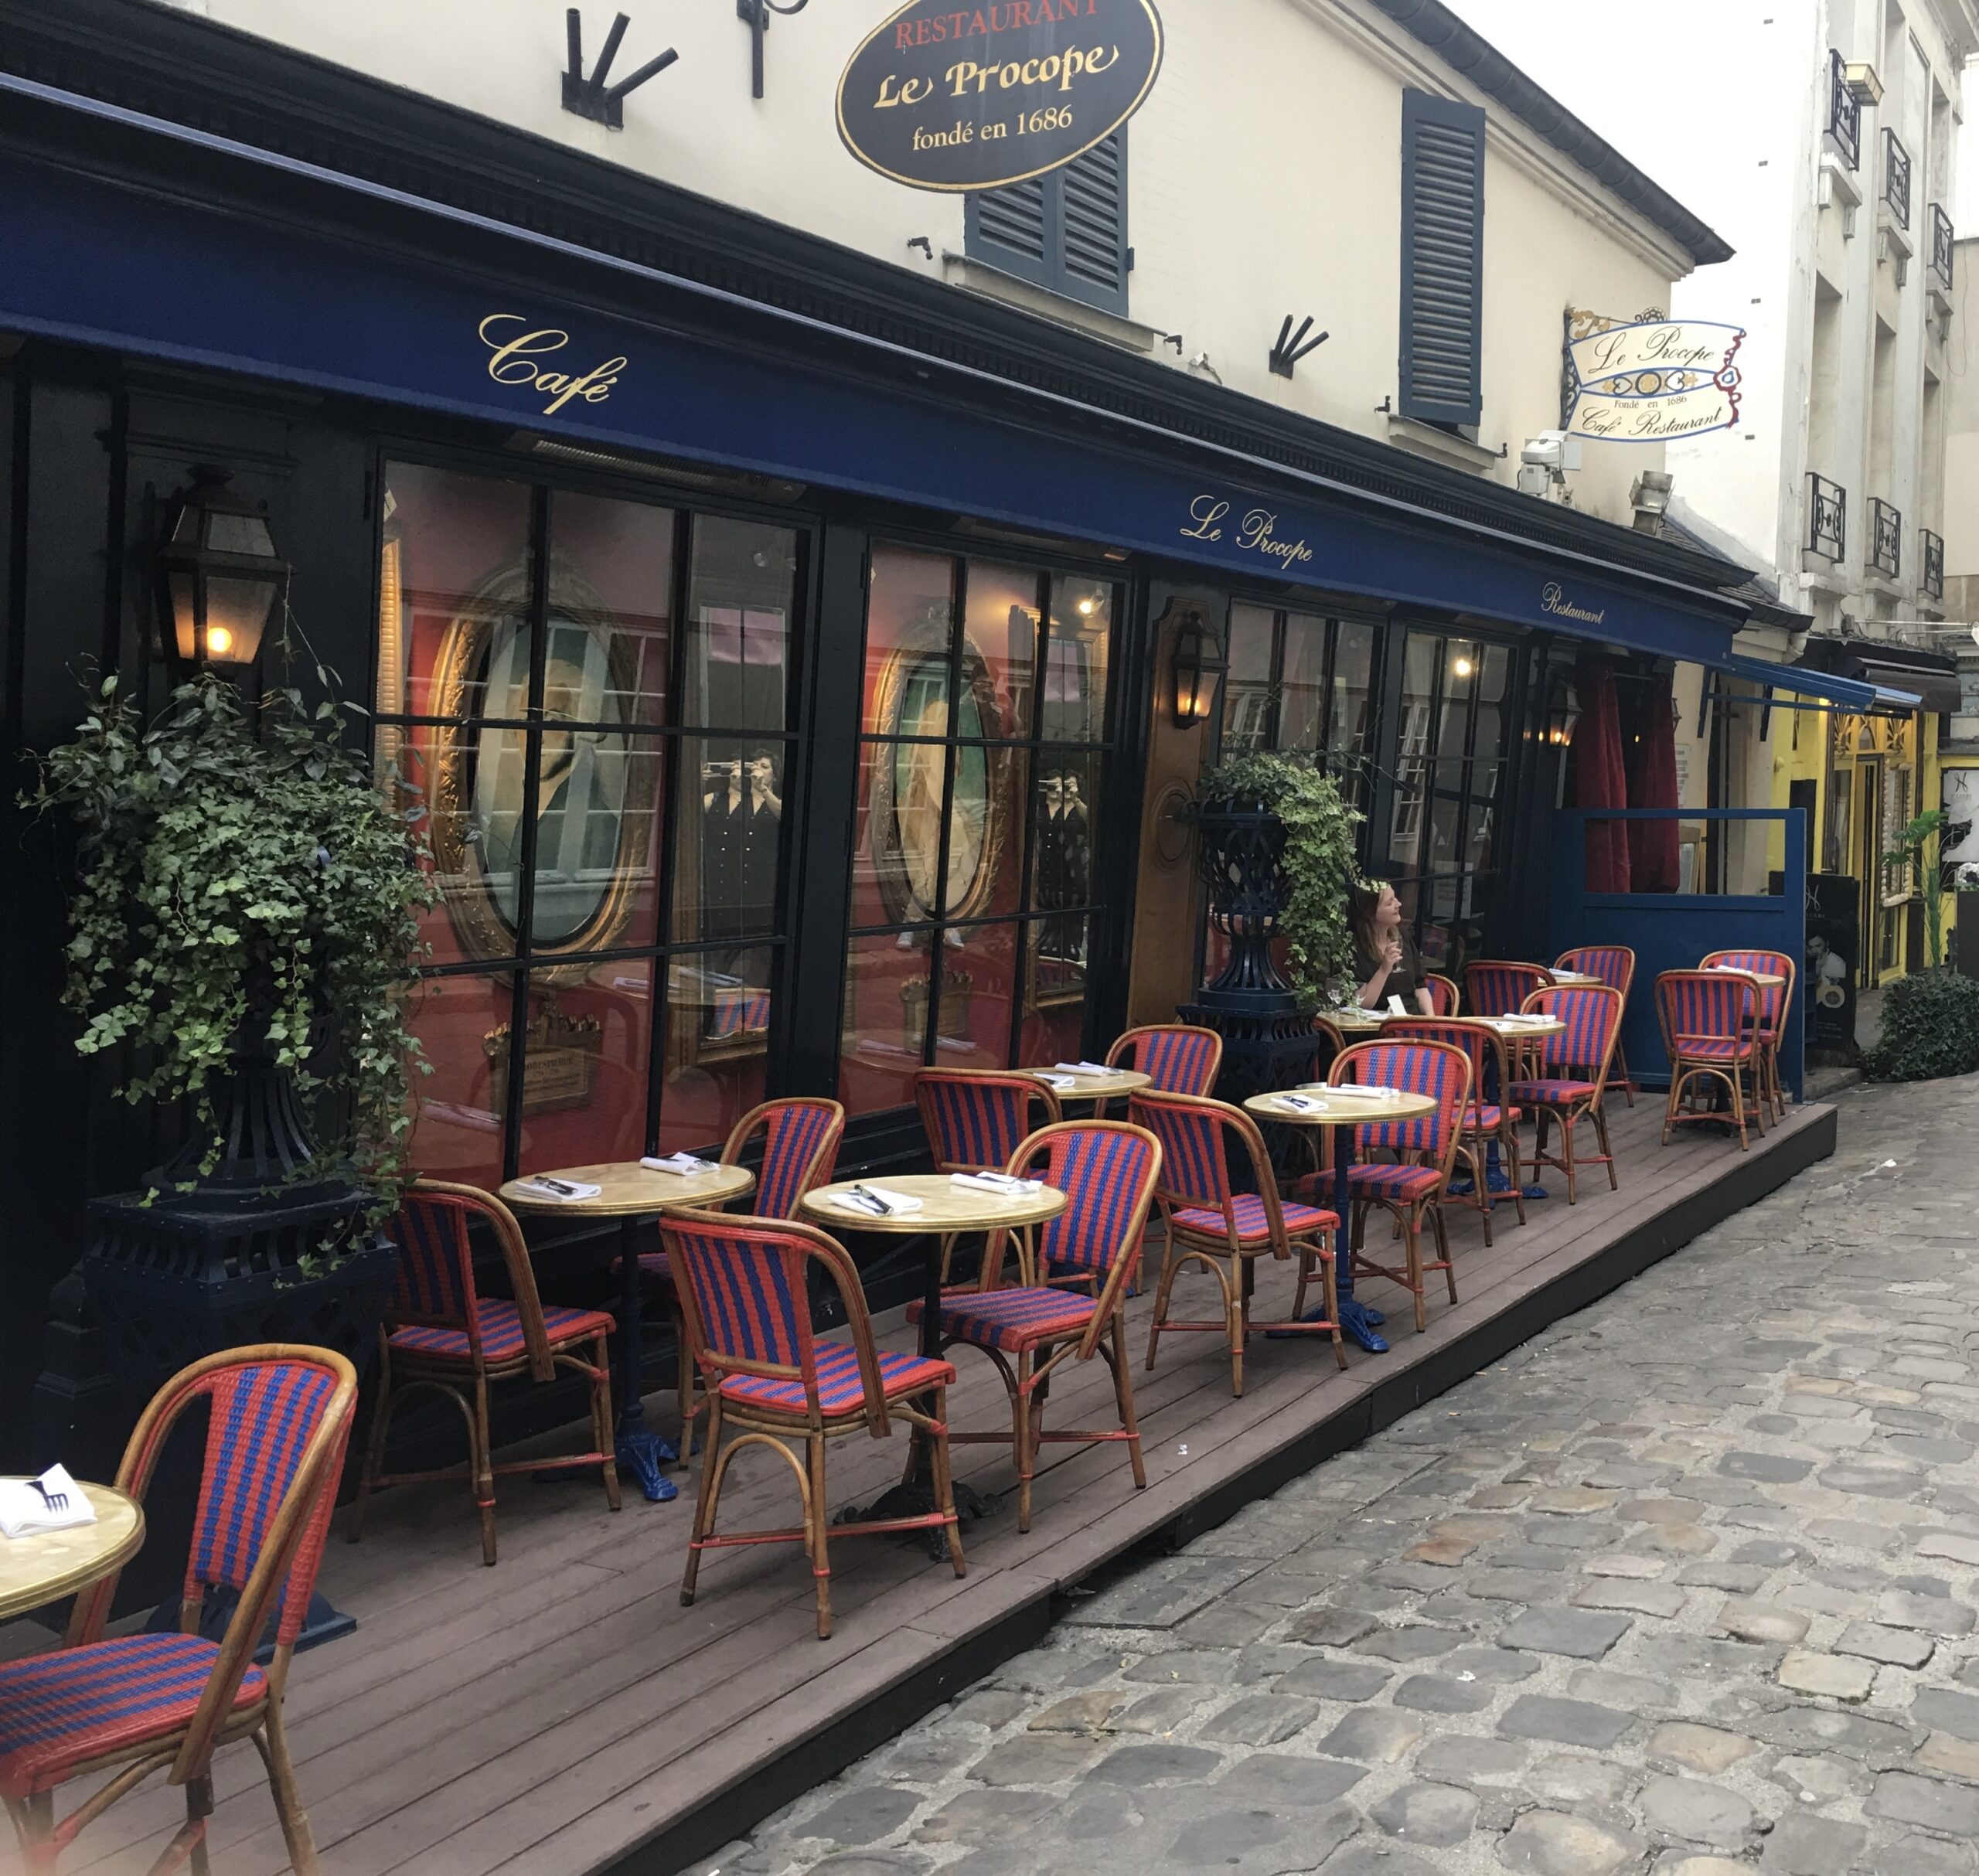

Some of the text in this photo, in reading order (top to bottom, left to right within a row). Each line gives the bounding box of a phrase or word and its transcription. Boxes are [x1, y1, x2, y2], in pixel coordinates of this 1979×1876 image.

[894, 0, 1097, 49] RESTAURANT
[873, 44, 1120, 108] Le Procope
[912, 104, 1073, 151] fondé en 1686
[479, 314, 628, 415] Café
[1588, 325, 1715, 374] Le Procope
[1582, 406, 1722, 436] Café Restaurant
[1614, 400, 1640, 409] Fondé
[1667, 396, 1687, 407] 1686
[1180, 495, 1313, 570] Le Procope
[1541, 581, 1605, 625] Restaurant
